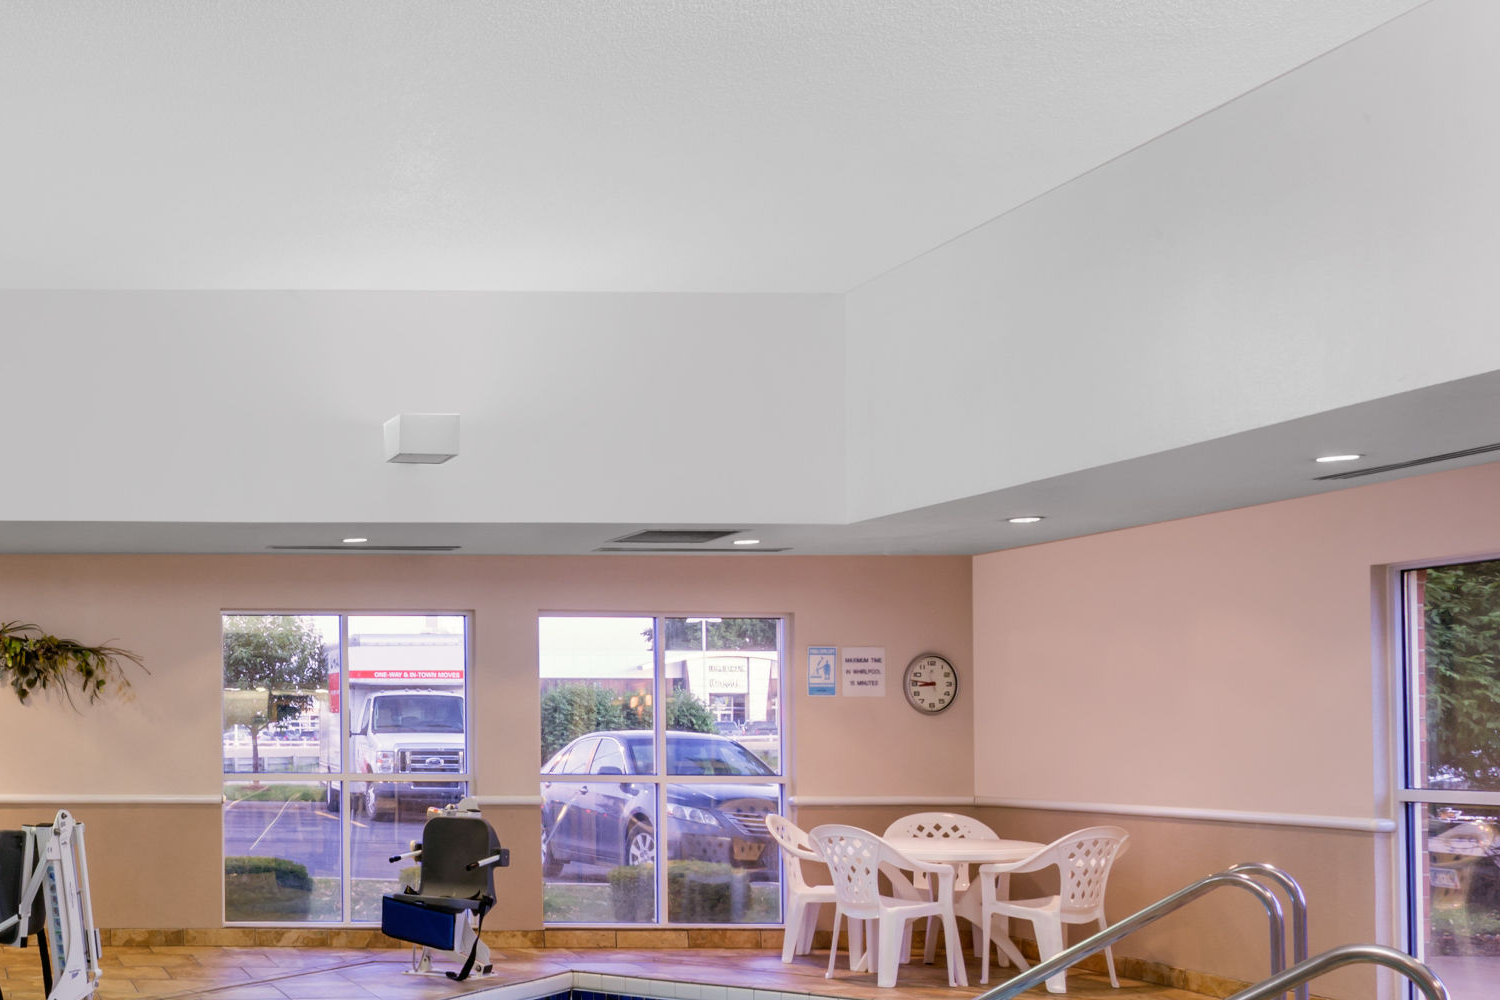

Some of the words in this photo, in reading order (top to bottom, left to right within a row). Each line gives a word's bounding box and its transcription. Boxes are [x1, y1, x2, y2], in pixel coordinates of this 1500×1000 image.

[374, 671, 403, 679] ONE-WAY
[403, 671, 409, 679] &
[409, 671, 437, 679] IN-TOWN
[437, 671, 461, 679] MOVES
